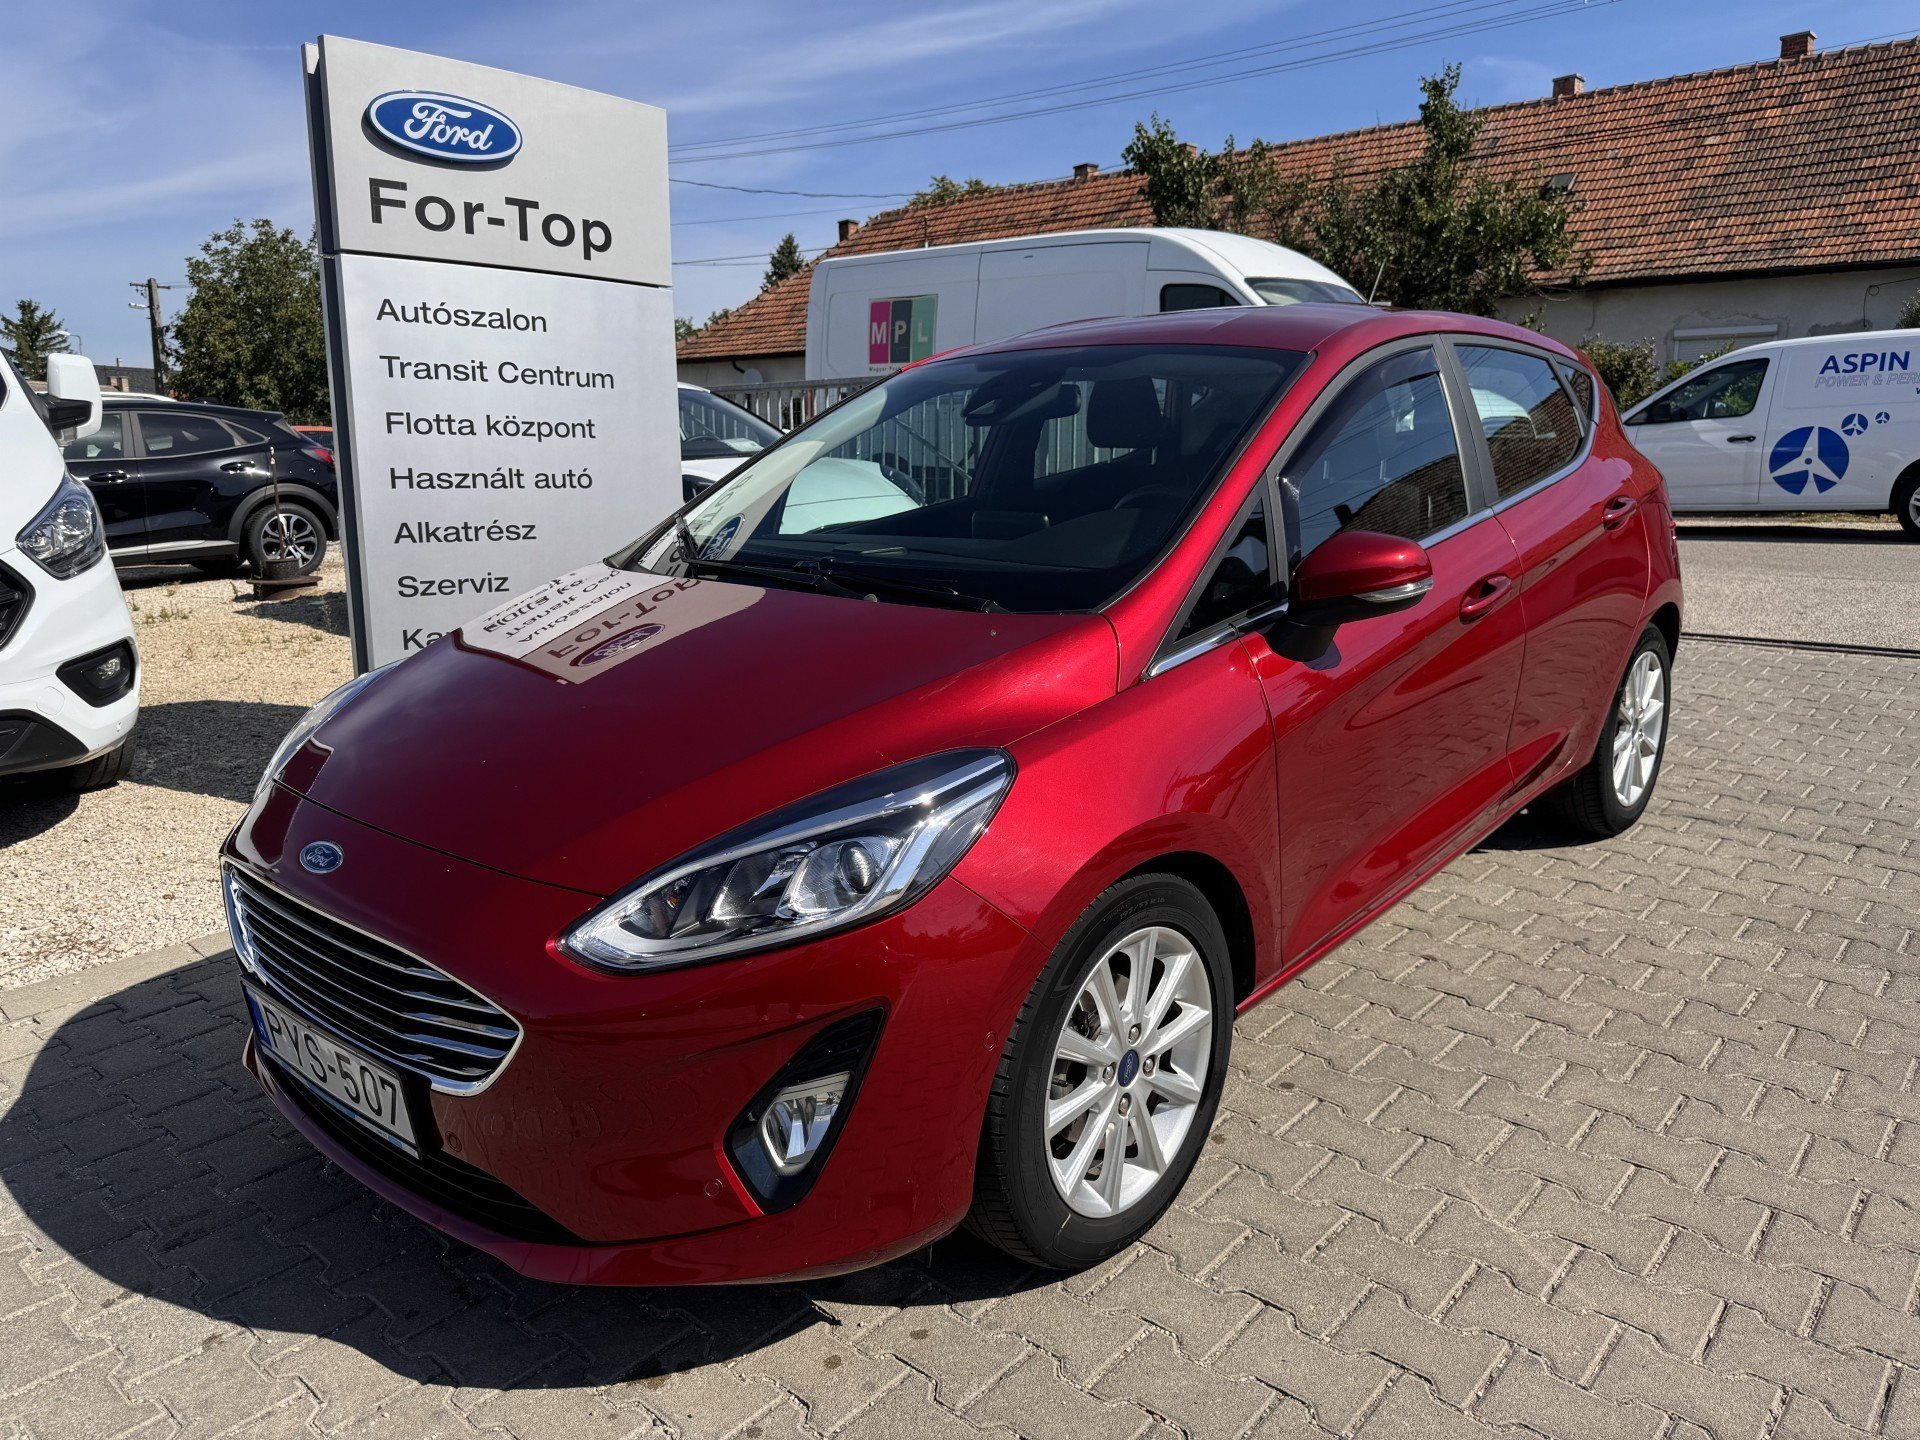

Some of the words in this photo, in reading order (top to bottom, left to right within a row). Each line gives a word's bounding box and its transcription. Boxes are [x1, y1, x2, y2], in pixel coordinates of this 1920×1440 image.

[404, 101, 494, 151] Ford
[368, 177, 612, 260] For-Top
[376, 298, 548, 333] Autószalon
[379, 355, 488, 383] Transit
[498, 361, 615, 390] Centrum
[1819, 351, 1910, 375] ASPIN
[1815, 374, 1869, 388] POWER
[385, 412, 477, 436] Flotta
[486, 415, 596, 443] központ
[390, 467, 525, 490] Használt
[534, 467, 593, 490] autó
[394, 519, 537, 544] Alkatrész
[398, 572, 510, 598] Szerviz
[263, 1004, 397, 1126] PYS-507
